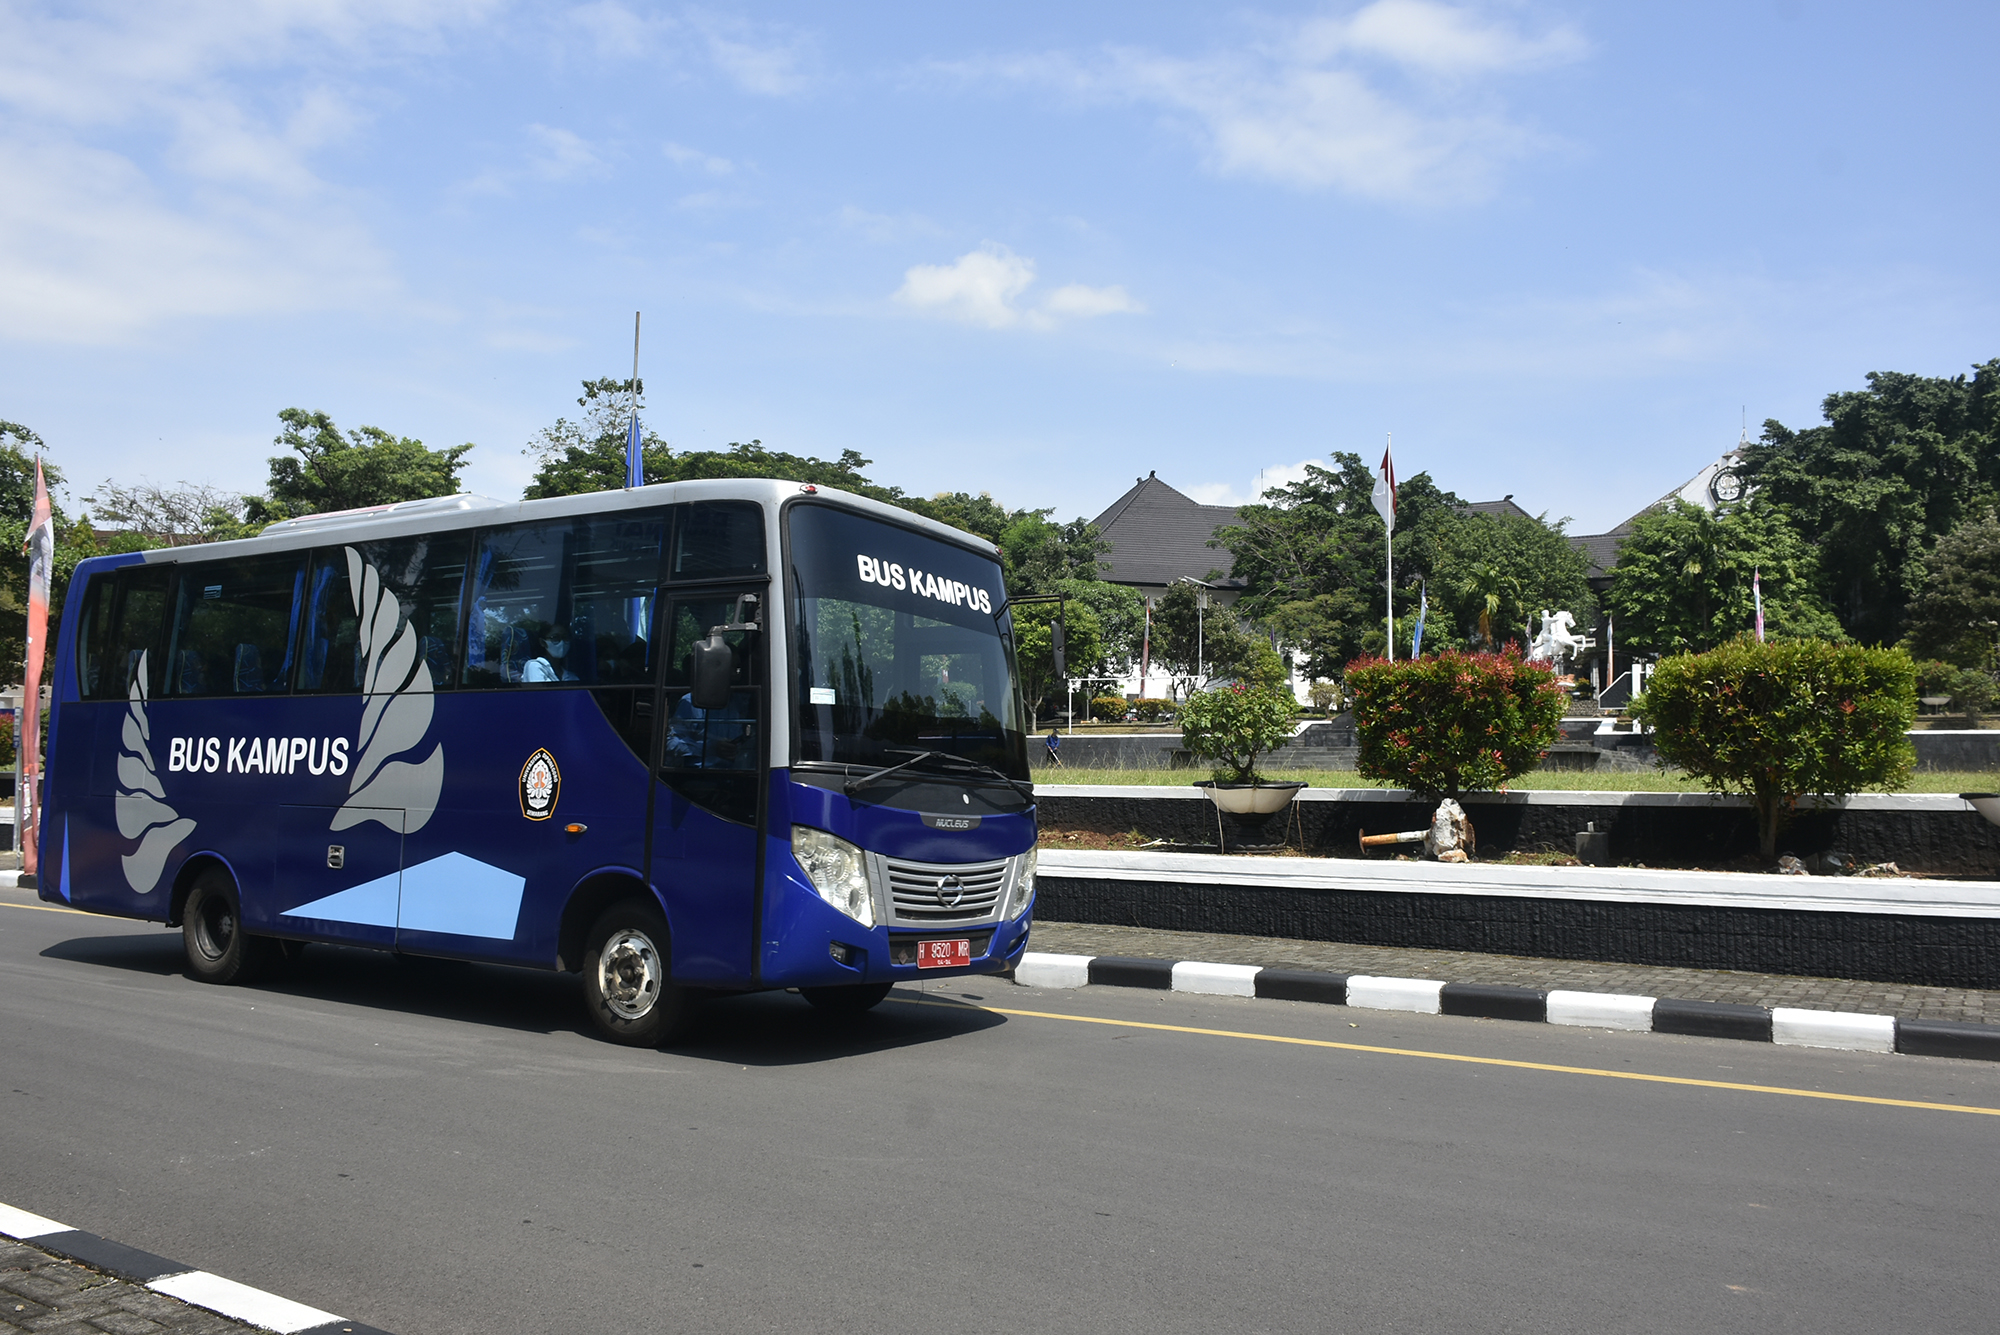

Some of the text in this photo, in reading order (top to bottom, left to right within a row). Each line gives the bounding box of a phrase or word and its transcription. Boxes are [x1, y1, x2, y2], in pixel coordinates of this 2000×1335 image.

[857, 554, 992, 615] BUS KAMPUS
[168, 737, 349, 776] BUS KAMPUS
[935, 818, 969, 829] NUCLEUS
[919, 943, 925, 959] H
[931, 942, 951, 958] 9520
